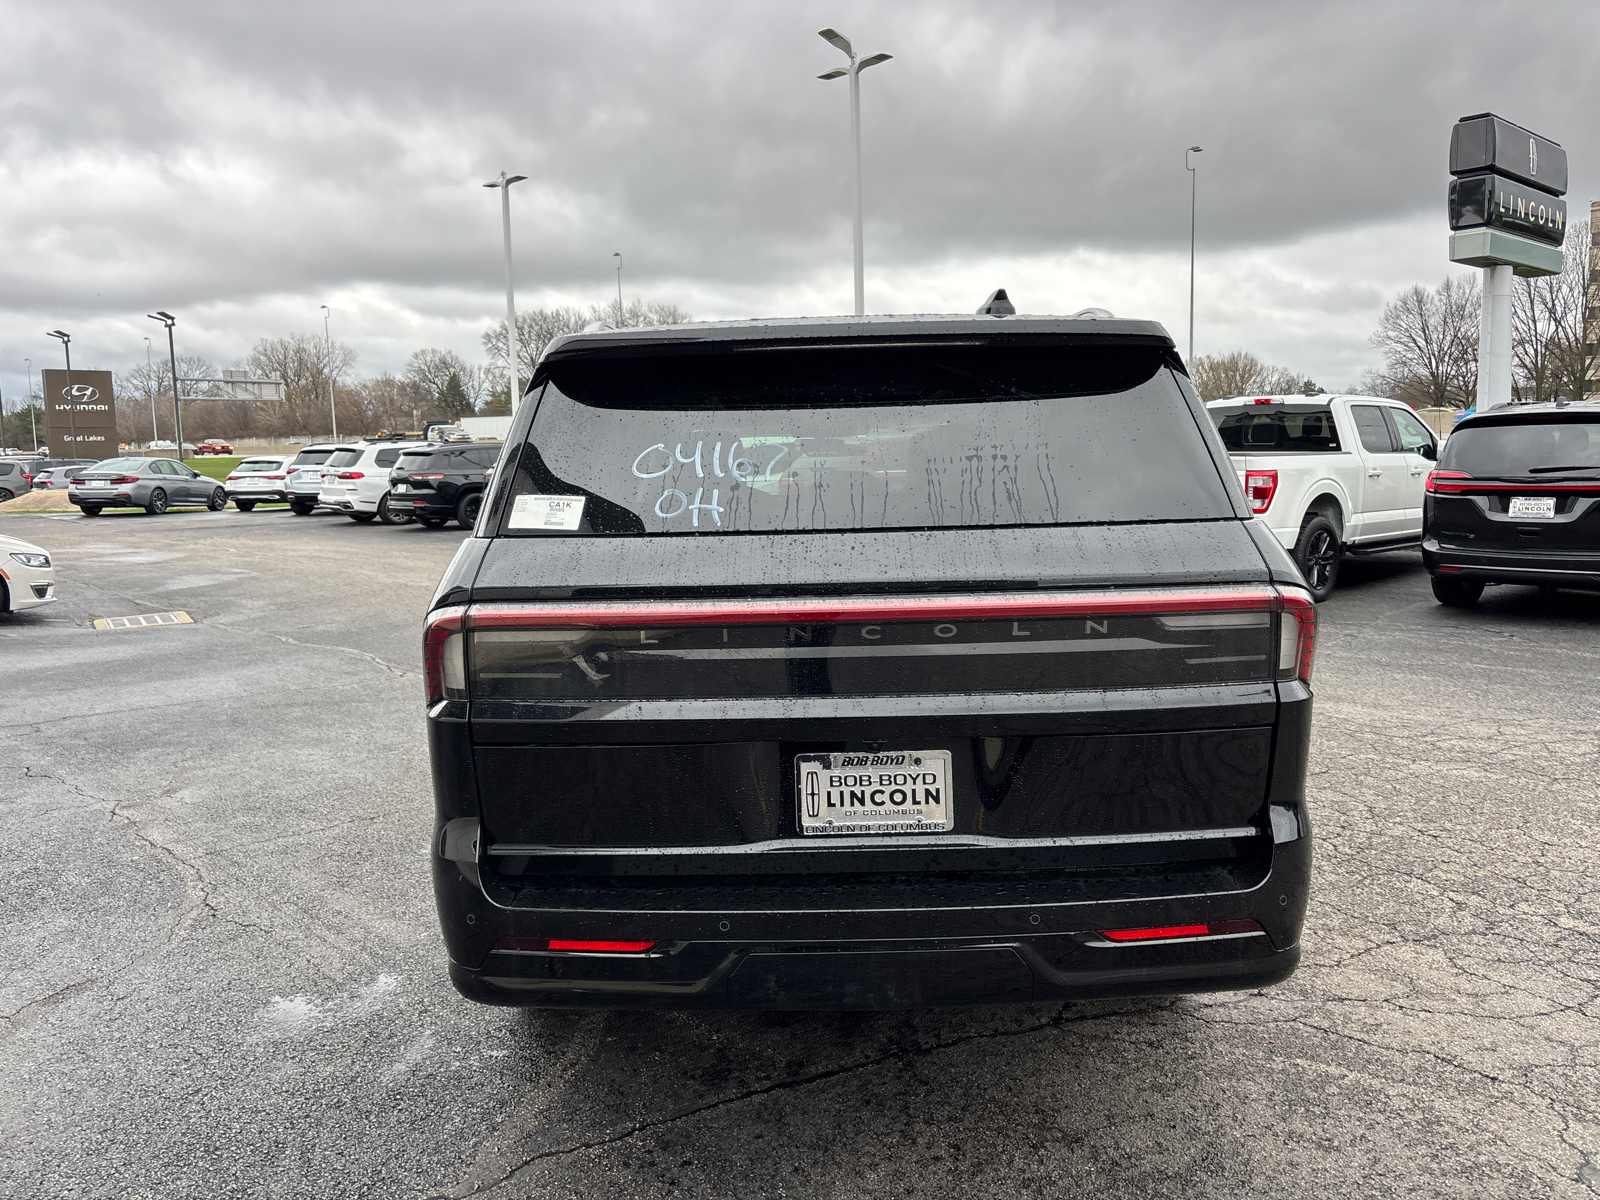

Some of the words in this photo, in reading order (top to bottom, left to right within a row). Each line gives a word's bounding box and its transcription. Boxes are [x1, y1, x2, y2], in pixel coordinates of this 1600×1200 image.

[1500, 191, 1563, 230] LINCOLN
[63, 434, 83, 442] Grat
[85, 434, 105, 442] Lakes
[632, 440, 789, 482] 04167
[548, 501, 572, 509] CA1K
[654, 487, 725, 527] OH
[640, 619, 1109, 645] LINCOLN
[829, 772, 938, 788] BOB-BOYD
[826, 787, 941, 808] LINCOLN
[862, 808, 924, 816] COLUMBUS
[805, 823, 856, 834] LINCOLN
[859, 823, 875, 832] OF
[877, 822, 946, 832] COLUMBUS
